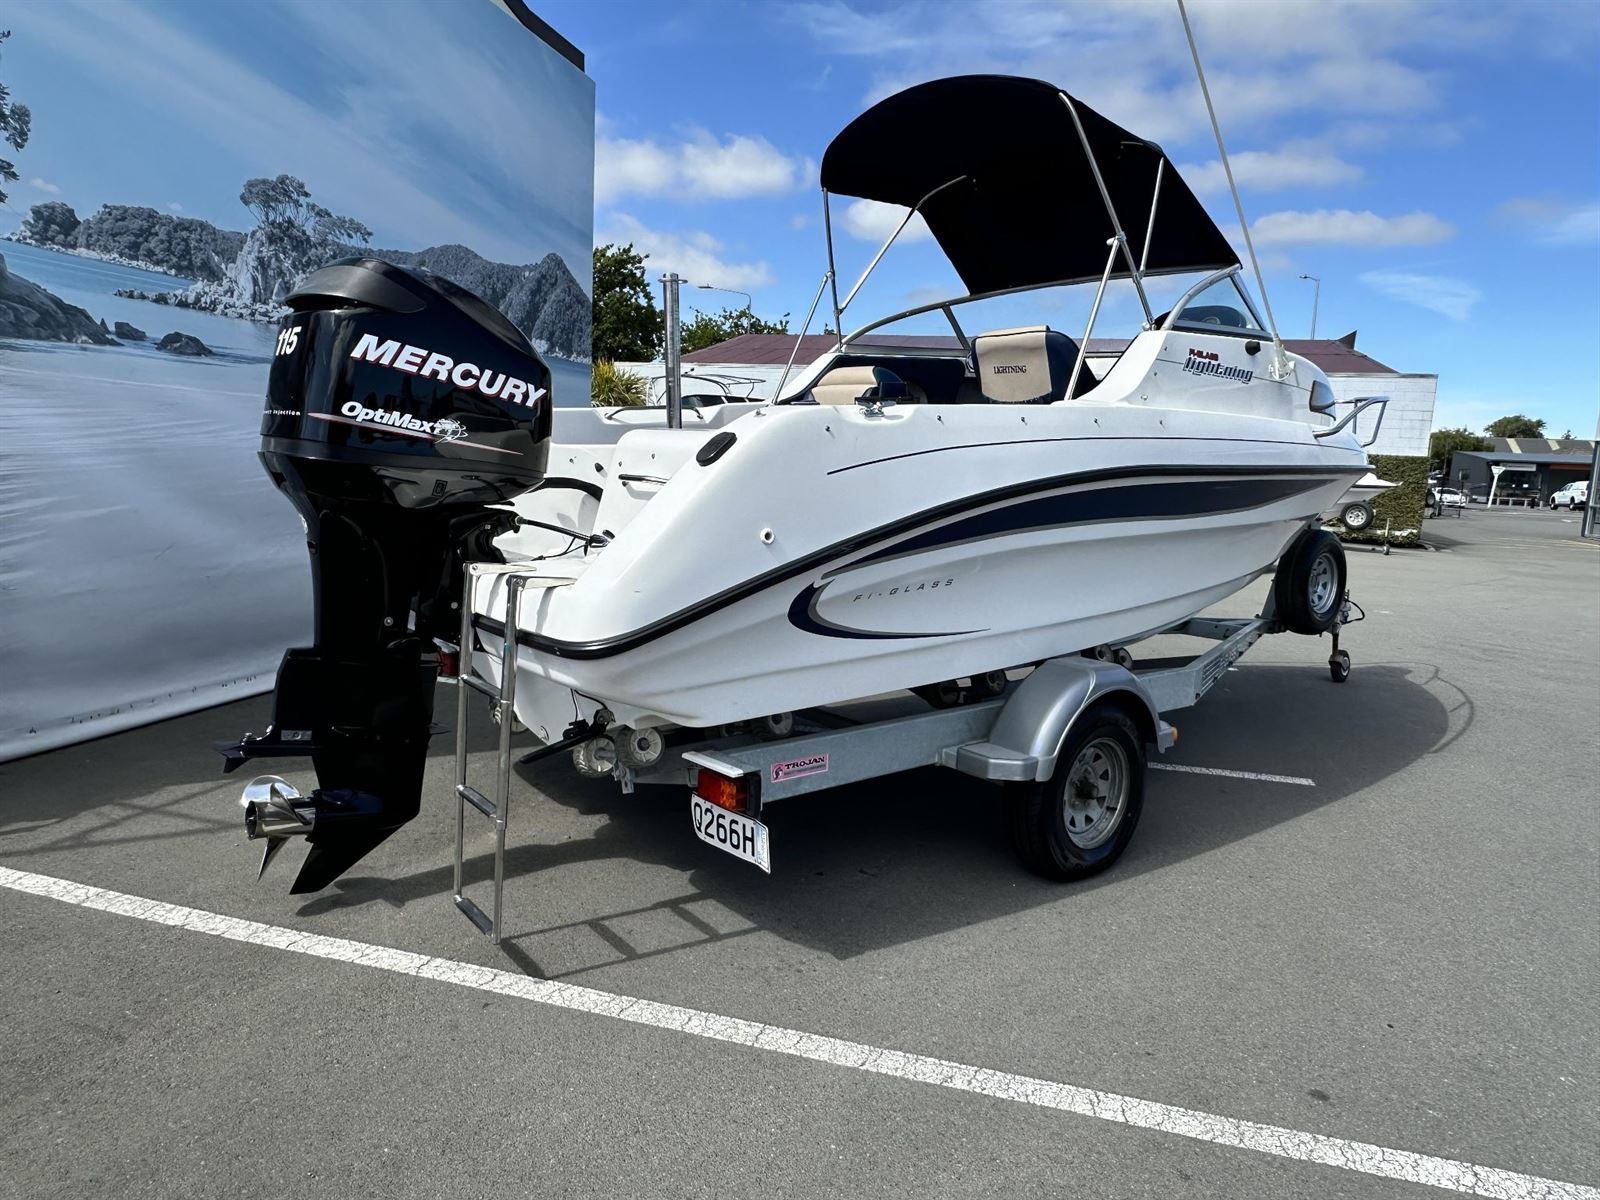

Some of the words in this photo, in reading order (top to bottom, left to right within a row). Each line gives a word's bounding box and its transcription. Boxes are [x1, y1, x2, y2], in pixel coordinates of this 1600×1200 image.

[275, 326, 302, 357] 115
[350, 333, 547, 408] MERCURY
[993, 365, 1027, 375] LIGHTNING
[1182, 356, 1254, 385] lightning
[341, 400, 434, 434] OptiMax
[784, 756, 825, 770] TROJAN
[692, 802, 756, 858] Q266H
